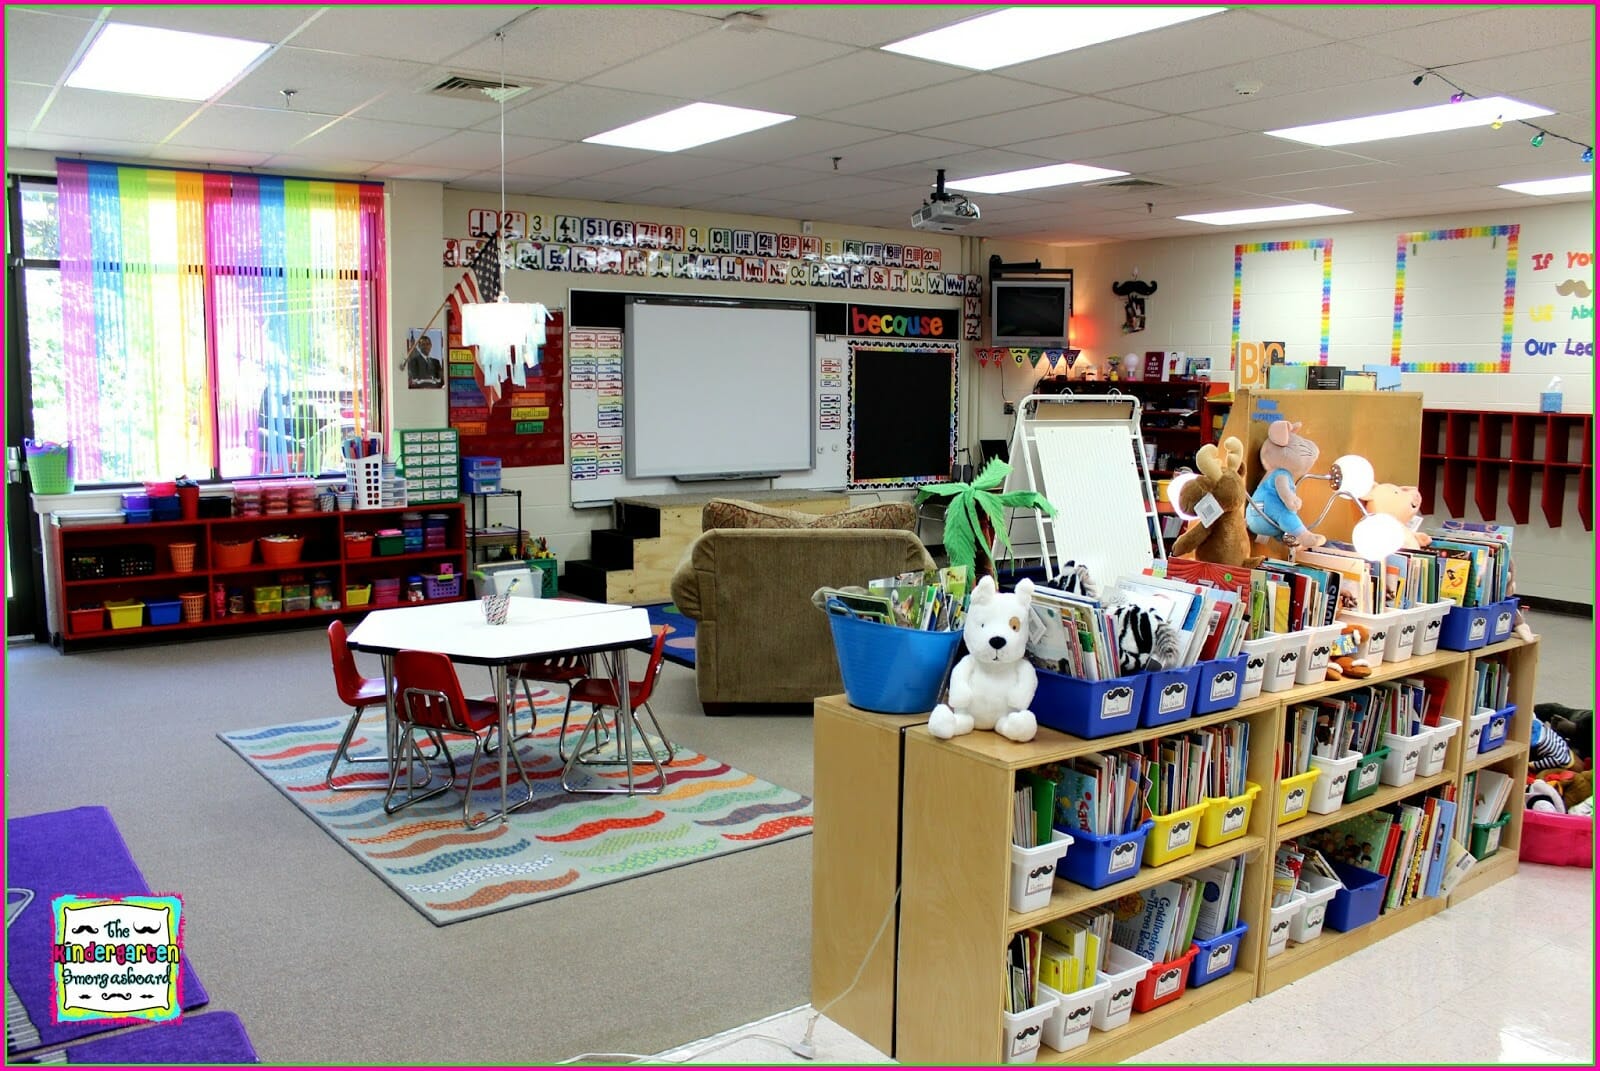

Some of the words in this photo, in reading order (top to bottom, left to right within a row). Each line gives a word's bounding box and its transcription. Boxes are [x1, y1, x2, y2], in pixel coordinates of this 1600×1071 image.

[503, 213, 513, 230] 2
[533, 215, 541, 231] 3
[560, 217, 570, 233] 4
[586, 219, 596, 236] 5
[613, 222, 623, 237] 6
[639, 225, 649, 239] 7
[664, 227, 673, 242] 8
[690, 228, 698, 243] 9
[713, 231, 722, 243] 10
[760, 234, 768, 249] 12
[781, 236, 789, 249] 13
[803, 238, 811, 251] 14
[924, 250, 932, 259] 20
[747, 264, 763, 277] Mm
[791, 266, 805, 278] Oo
[1531, 253, 1553, 271] If
[851, 306, 944, 337] because
[1524, 338, 1557, 357] Our
[1148, 896, 1171, 951] Goldilocks
